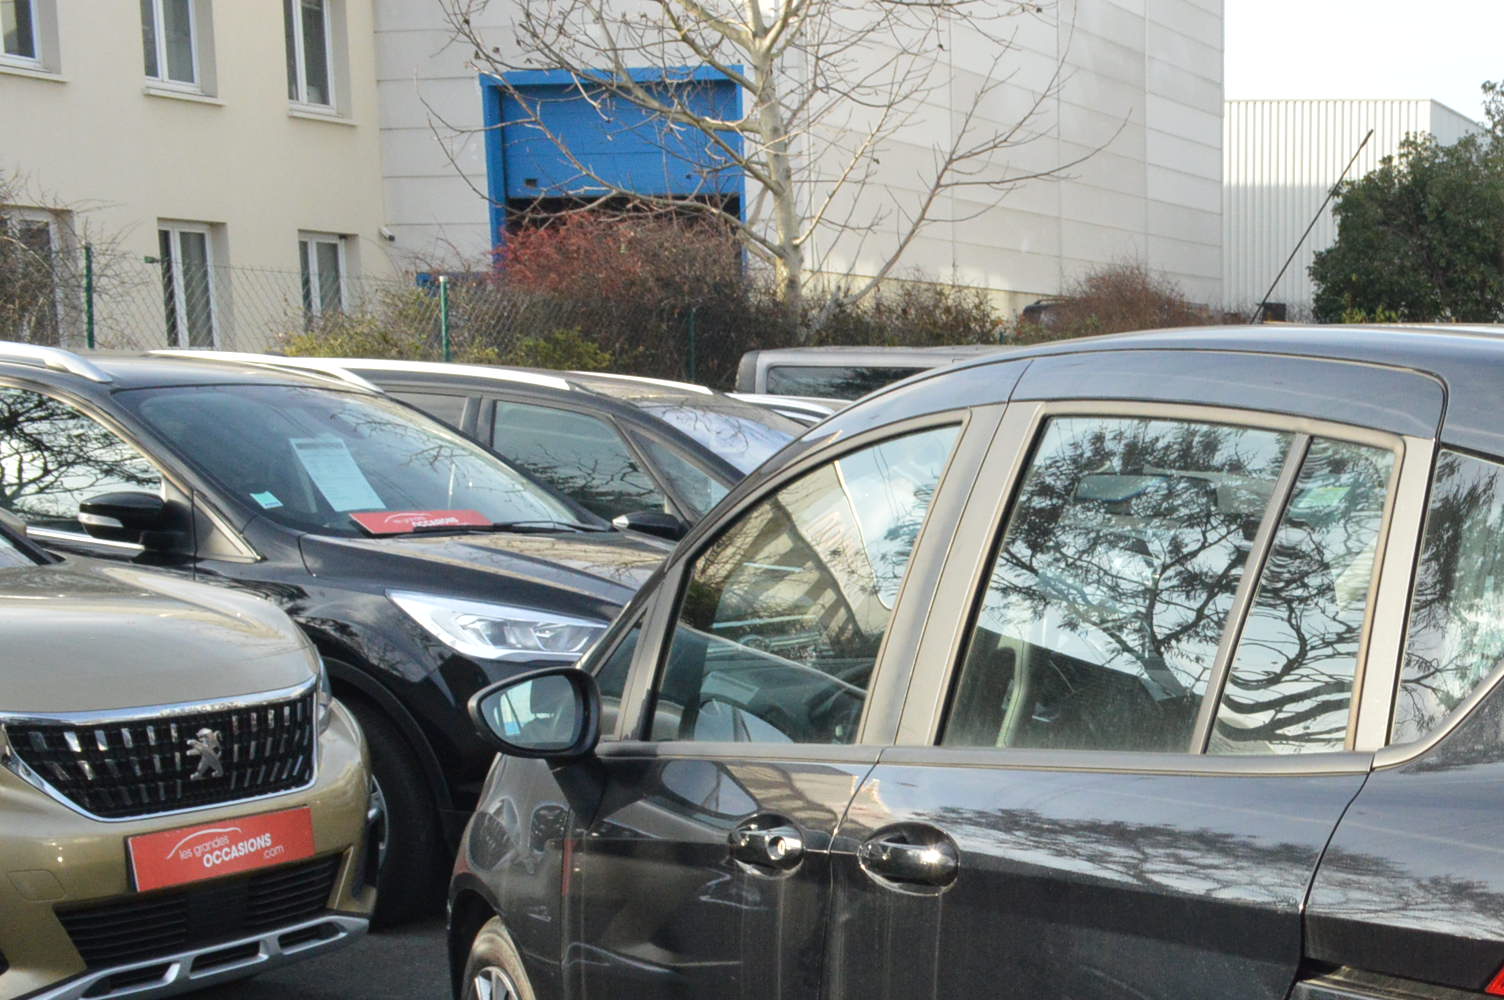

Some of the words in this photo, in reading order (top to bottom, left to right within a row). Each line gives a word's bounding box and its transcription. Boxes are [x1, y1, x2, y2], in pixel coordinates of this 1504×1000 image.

[179, 848, 193, 860] les
[193, 835, 230, 857] grandes
[202, 832, 272, 868] OCCASIONS
[262, 844, 285, 859] .com
